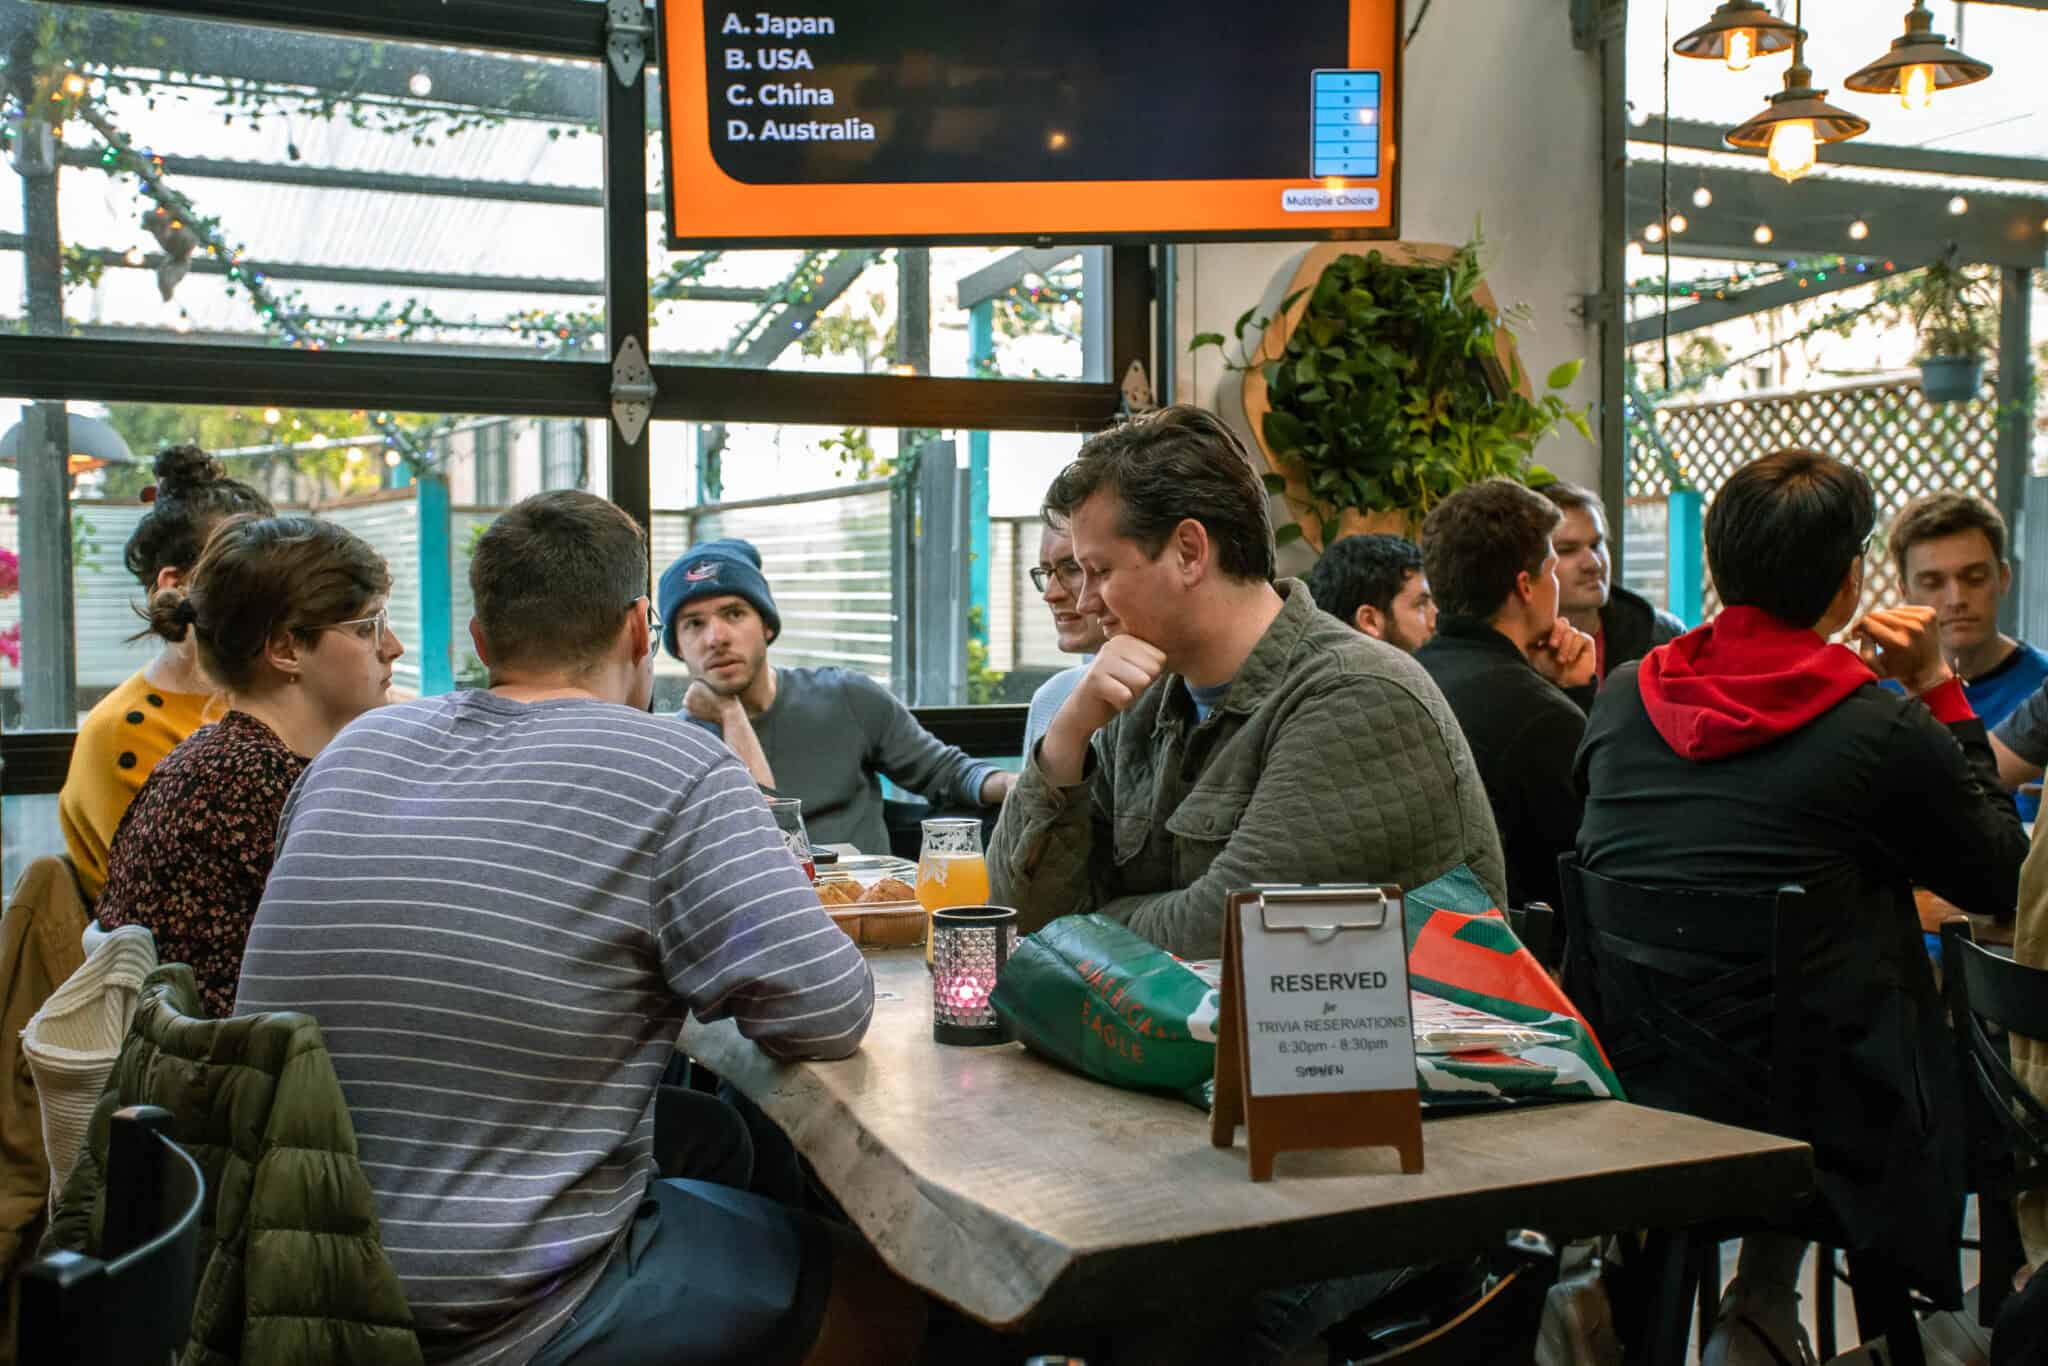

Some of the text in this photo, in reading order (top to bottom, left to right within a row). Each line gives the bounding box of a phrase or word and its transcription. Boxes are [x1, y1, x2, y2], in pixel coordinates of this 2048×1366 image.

[722, 13, 835, 39] A. Japan
[725, 49, 814, 70] B. USA
[726, 82, 835, 106] C. China
[727, 117, 875, 141] D. Australia
[1287, 193, 1375, 207] Multiple Choice
[1270, 971, 1387, 993] RESERVED
[1322, 1001, 1338, 1015] for
[1081, 997, 1145, 1064] EAGLE
[1257, 1015, 1407, 1033] TRIVIA RESERVATIONS
[1278, 1039, 1328, 1055] 6:30pm
[1340, 1037, 1388, 1052] 8:30pm
